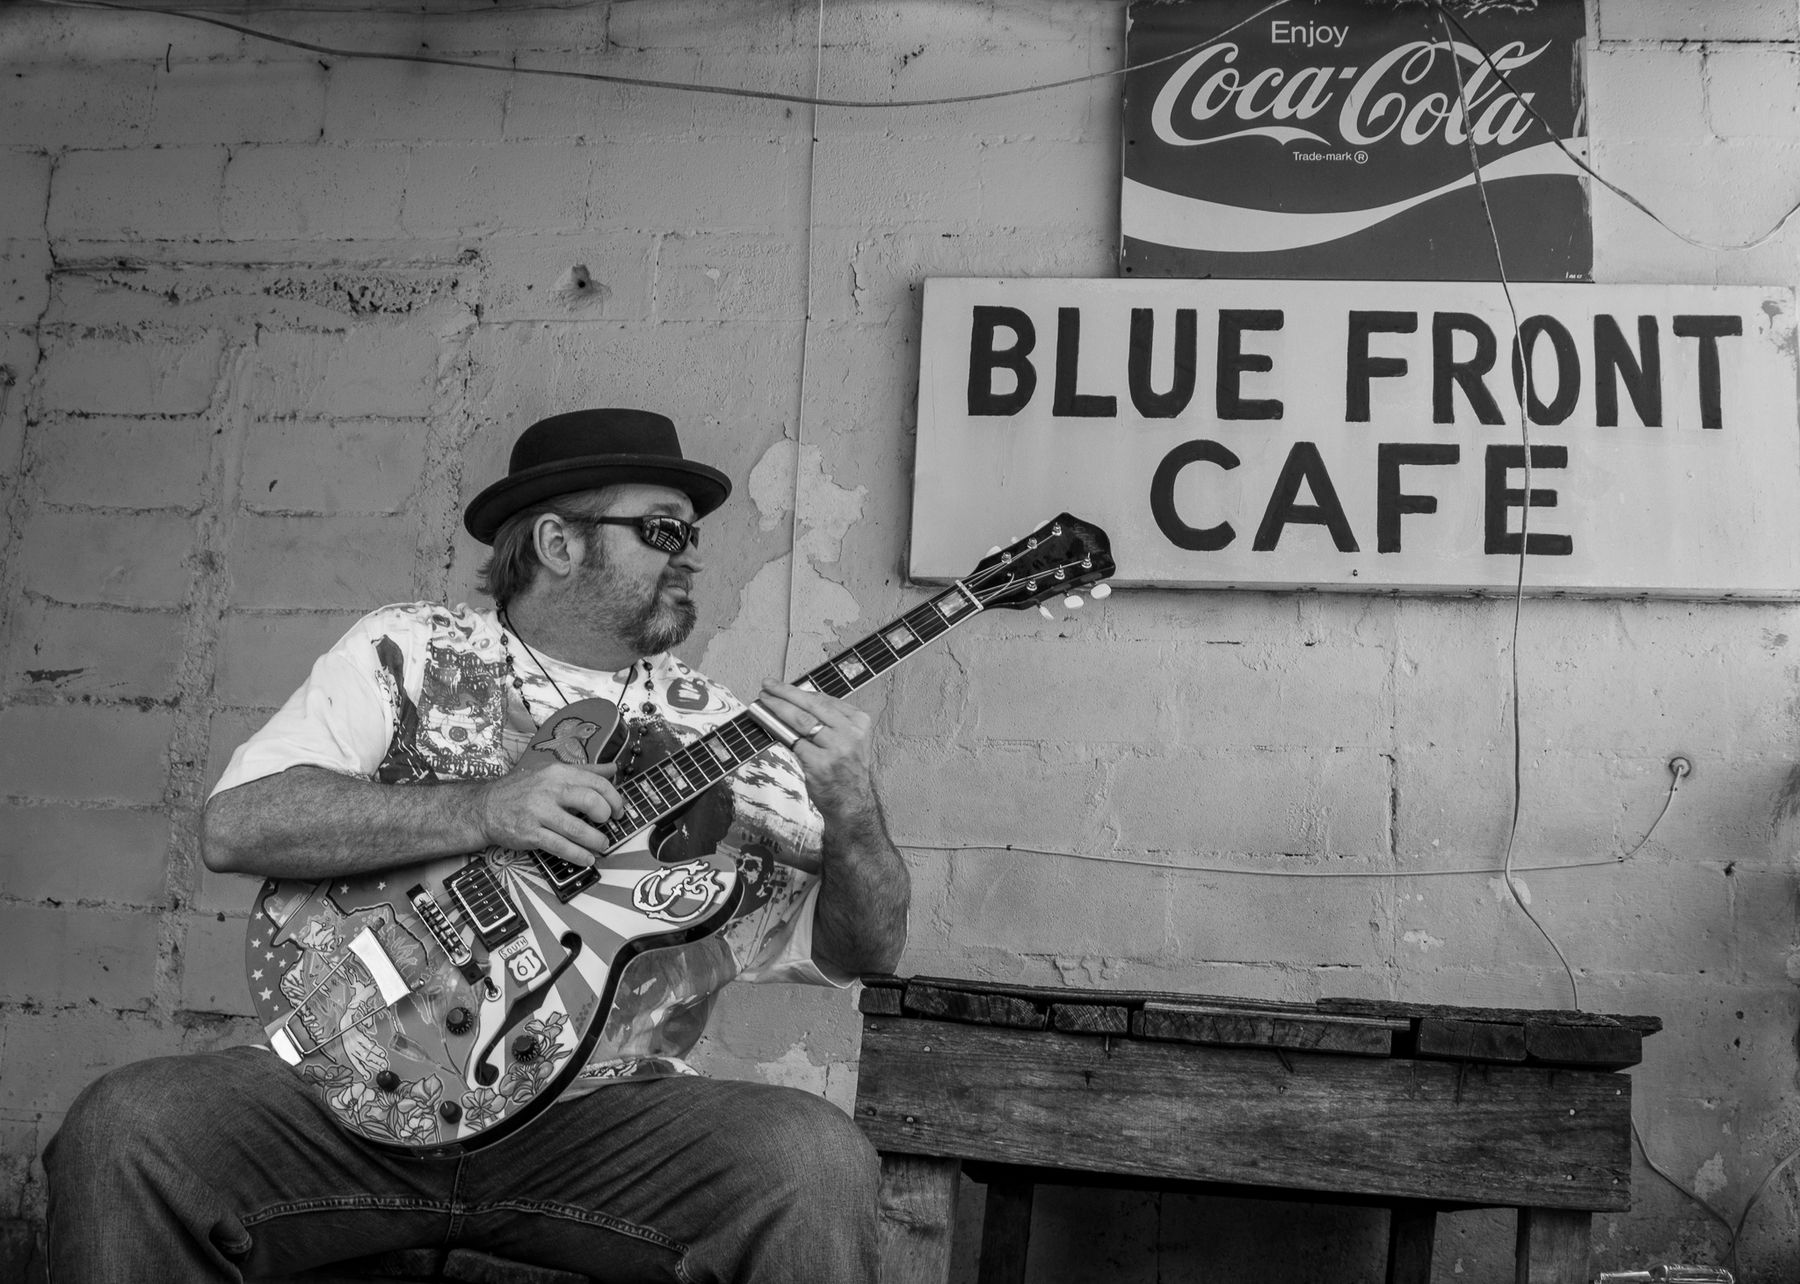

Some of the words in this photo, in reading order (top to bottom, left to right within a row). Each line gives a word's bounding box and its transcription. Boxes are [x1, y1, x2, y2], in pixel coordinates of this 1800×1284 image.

[1271, 20, 1348, 48] Enjoy
[1151, 39, 1553, 147] Coca-Cola
[967, 305, 1284, 420] BLUE
[1345, 310, 1743, 430] FRONT
[1150, 439, 1573, 555] CAFE
[500, 938, 528, 958] SOUTH
[517, 955, 535, 976] 61
